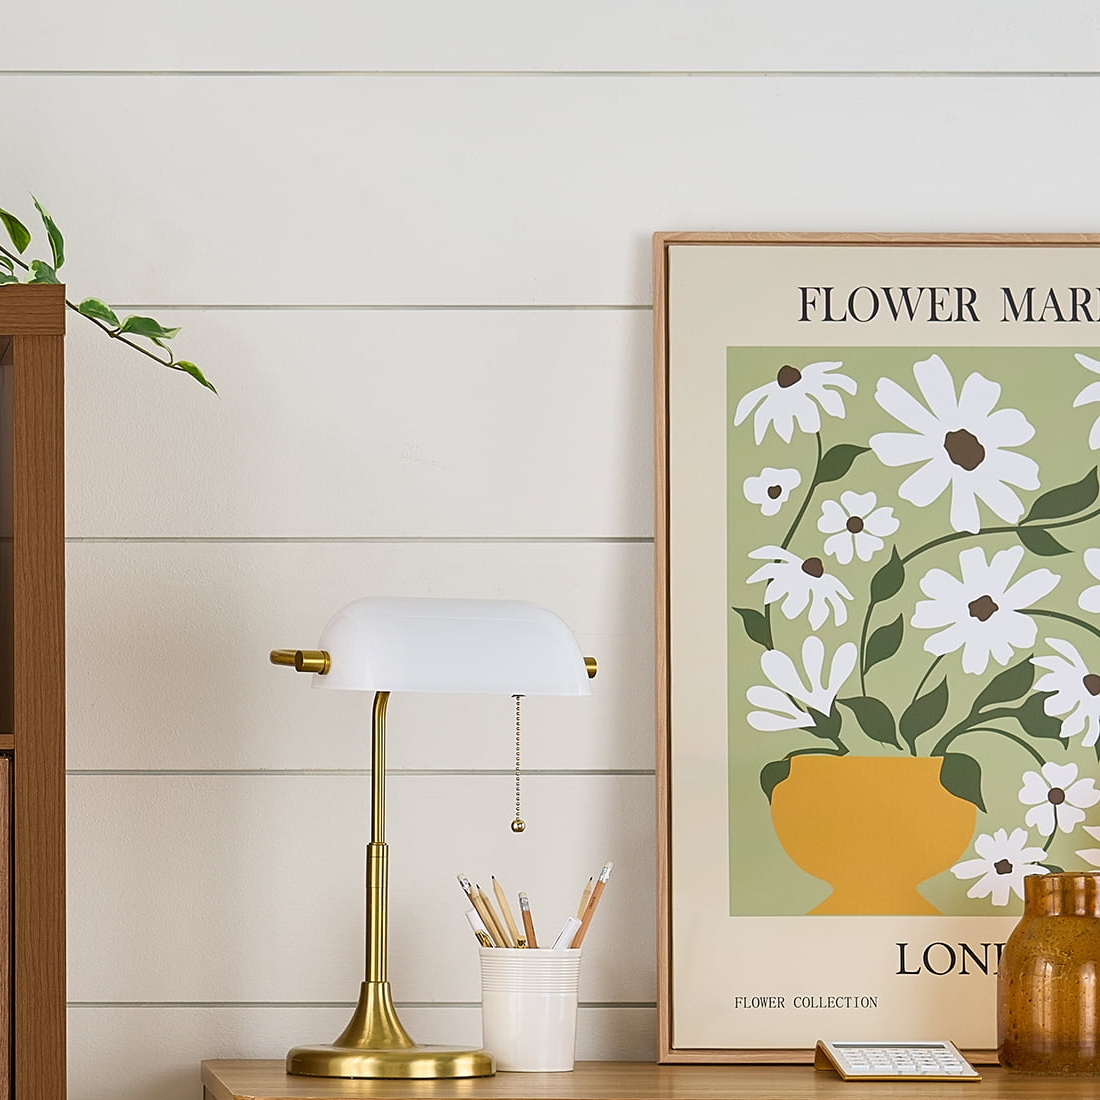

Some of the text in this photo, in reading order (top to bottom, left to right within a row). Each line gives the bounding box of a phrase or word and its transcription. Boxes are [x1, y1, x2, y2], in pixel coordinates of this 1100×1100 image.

[798, 286, 1100, 323] FLOWER MAR
[895, 942, 1006, 976] LON
[734, 996, 878, 1009] FLOWER COLLECTION
